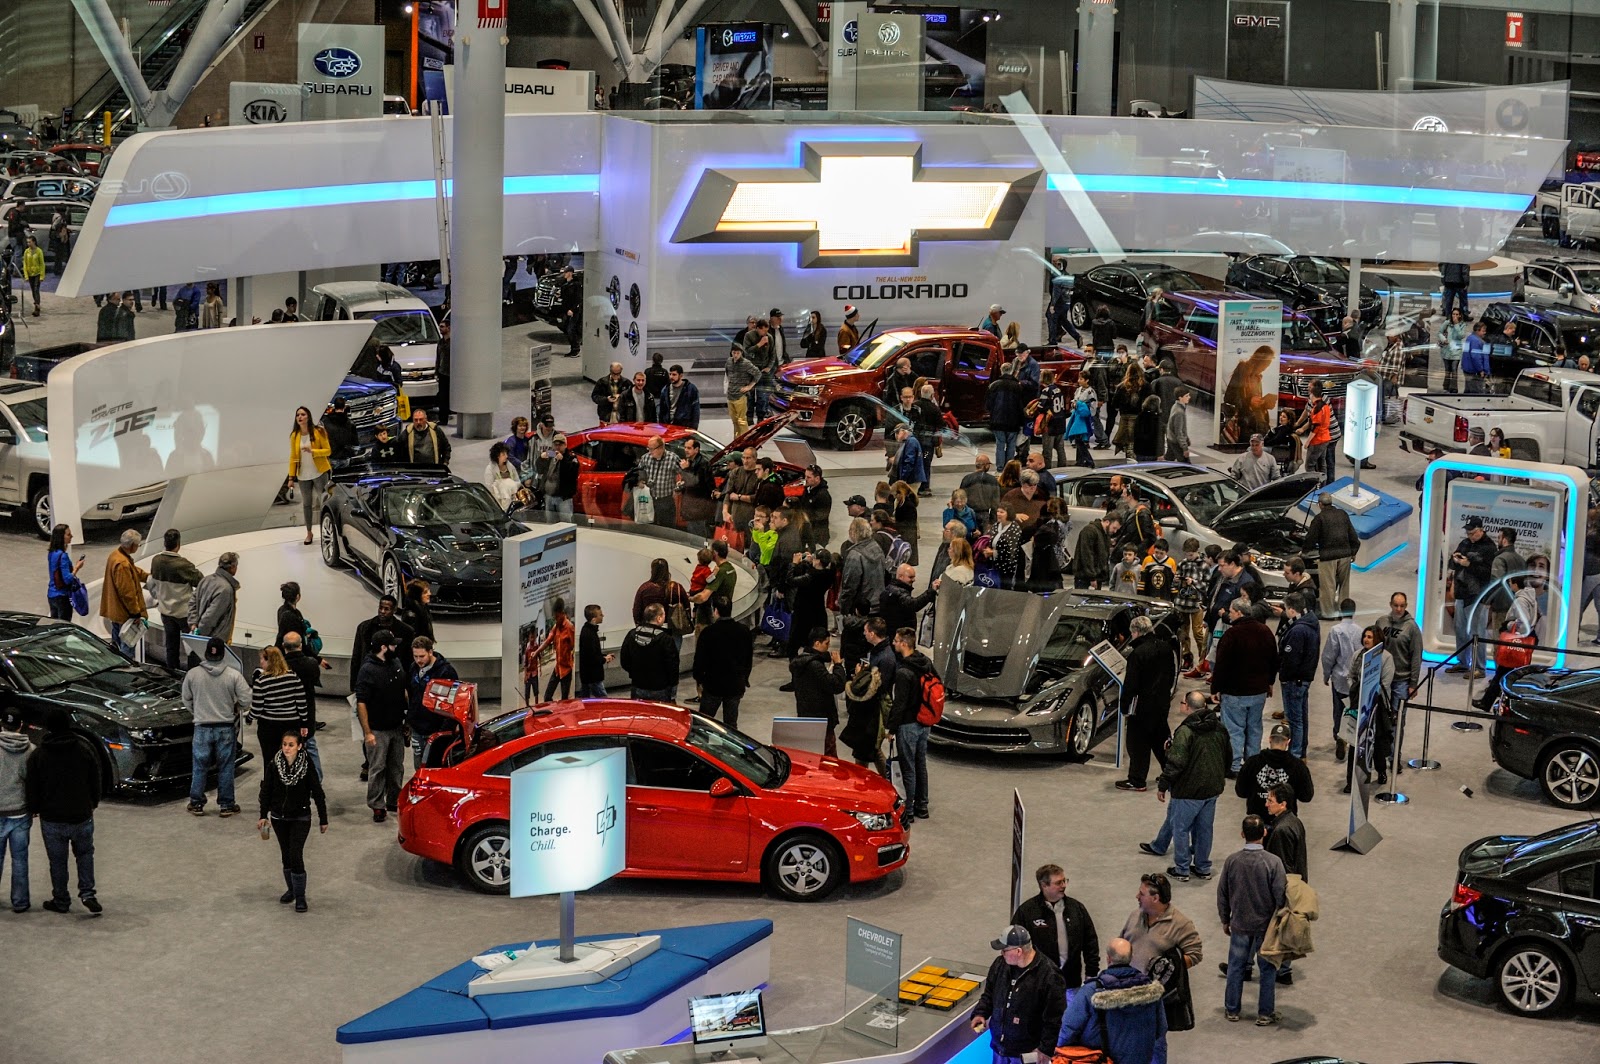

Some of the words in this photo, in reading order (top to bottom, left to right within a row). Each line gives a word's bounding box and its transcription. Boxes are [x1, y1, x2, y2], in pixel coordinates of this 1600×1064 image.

[1234, 14, 1280, 28] GMC
[837, 48, 856, 57] SUBA
[304, 82, 372, 95] SUBARU
[504, 84, 554, 95] UBARU
[250, 104, 280, 120] KIA
[833, 283, 968, 300] COLORADO
[1053, 395, 1065, 413] 84
[91, 401, 134, 422] CORVETTE
[90, 406, 158, 449] Z06
[1481, 516, 1543, 529] TRANSPORTATION
[1483, 525, 1501, 534] YOUN
[528, 569, 536, 579] OUR
[521, 580, 532, 589] PLAY
[530, 812, 555, 823] Plug.
[530, 826, 571, 837] Charge.
[530, 839, 556, 852] Chill.
[858, 928, 894, 947] CHEVROLET
